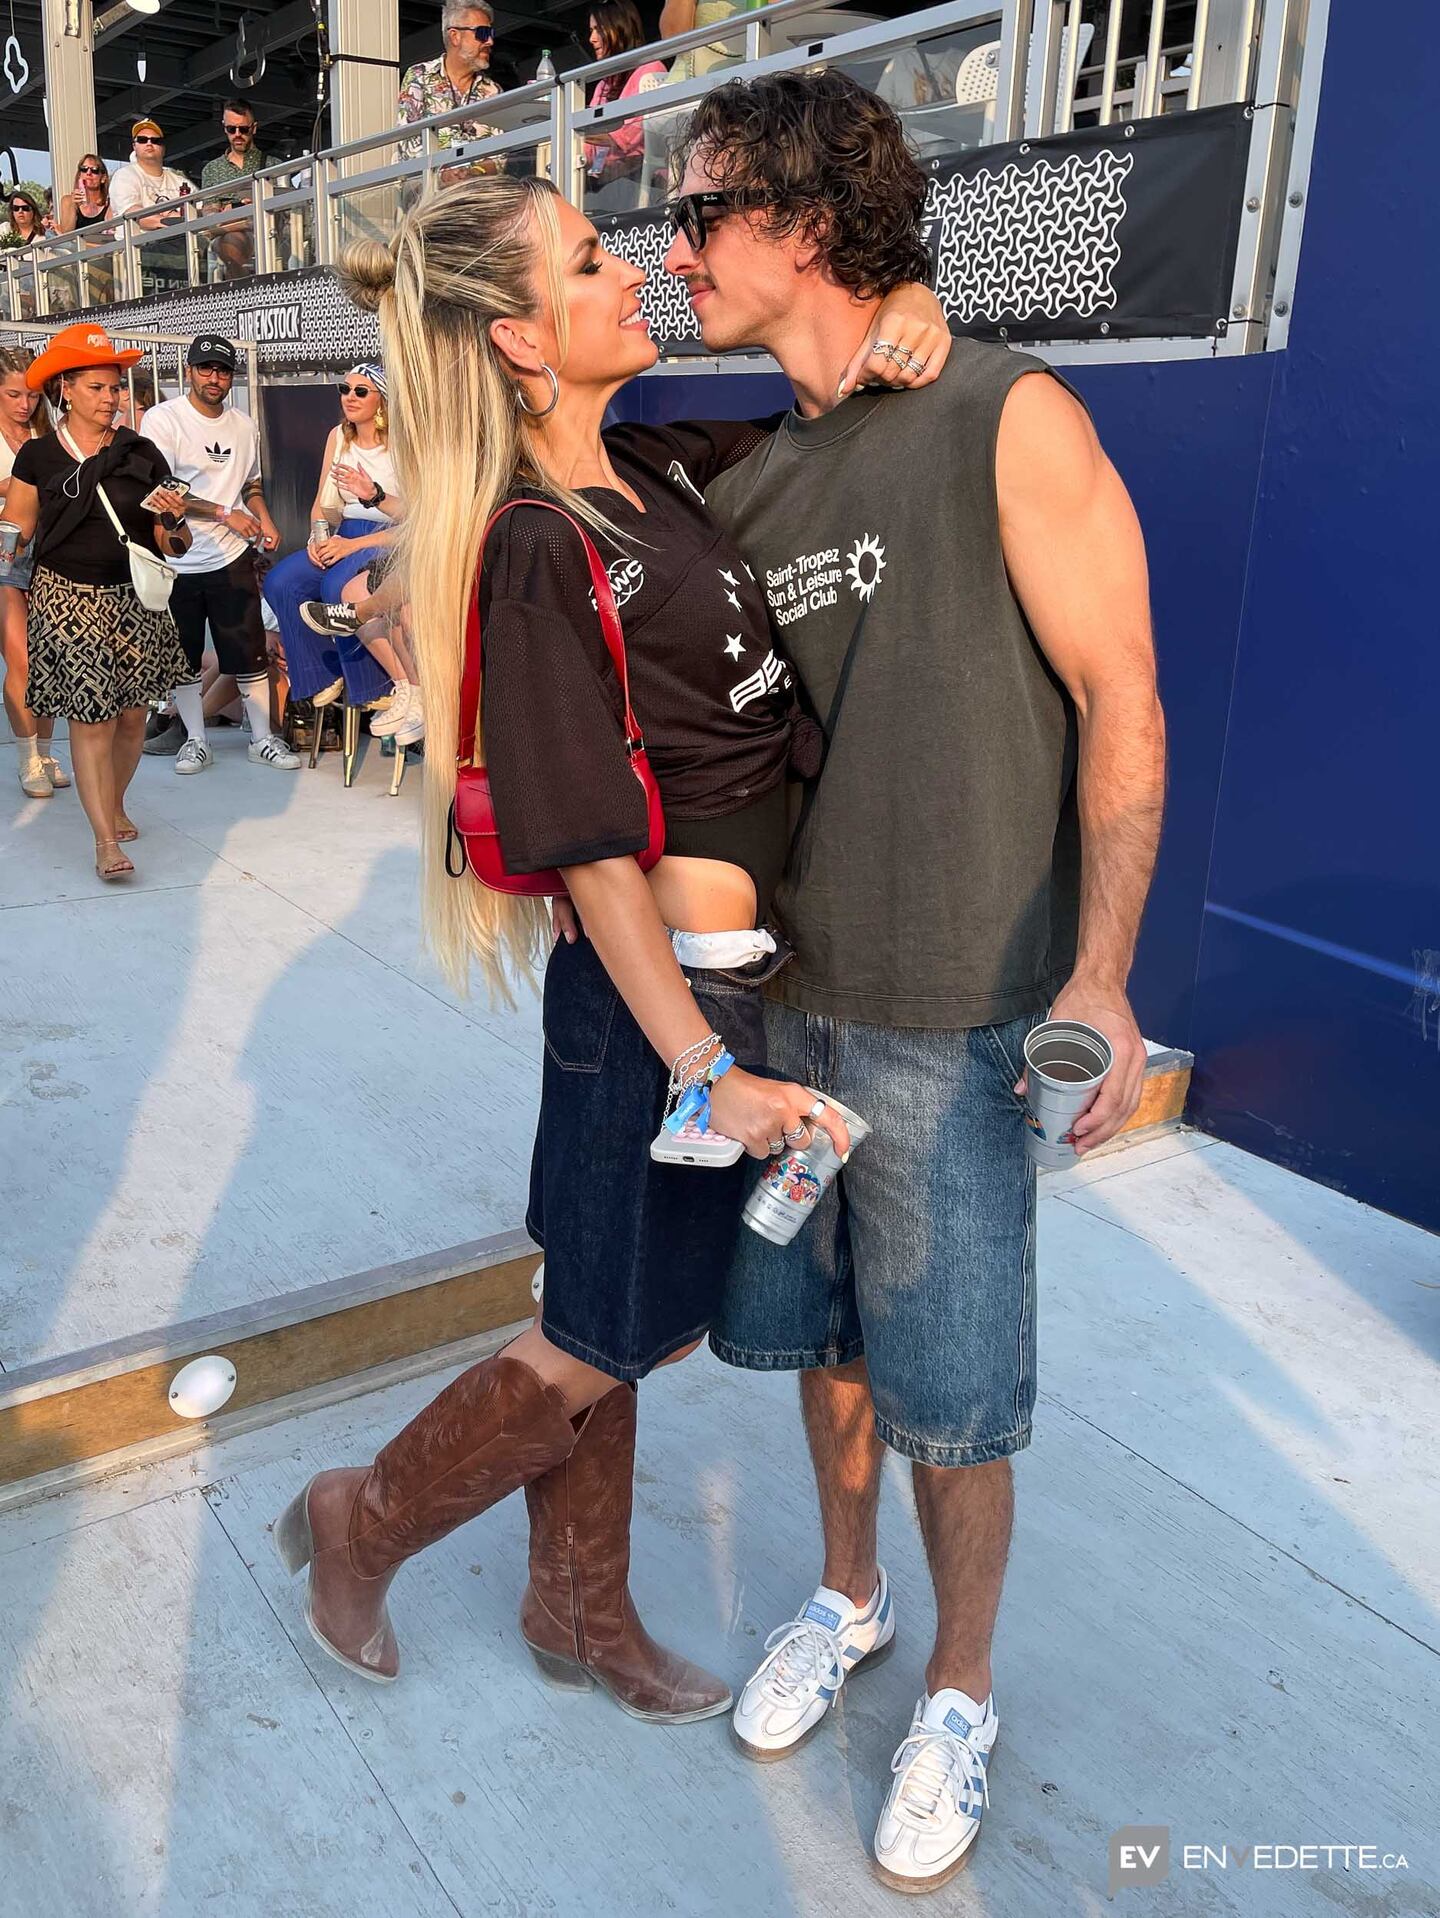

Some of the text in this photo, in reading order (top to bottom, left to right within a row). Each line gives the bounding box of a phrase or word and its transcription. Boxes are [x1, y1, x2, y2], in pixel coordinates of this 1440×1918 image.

[766, 548, 840, 588] Saint-Tropez
[766, 568, 842, 607] Sun & Leisure
[775, 586, 838, 626] Social Club
